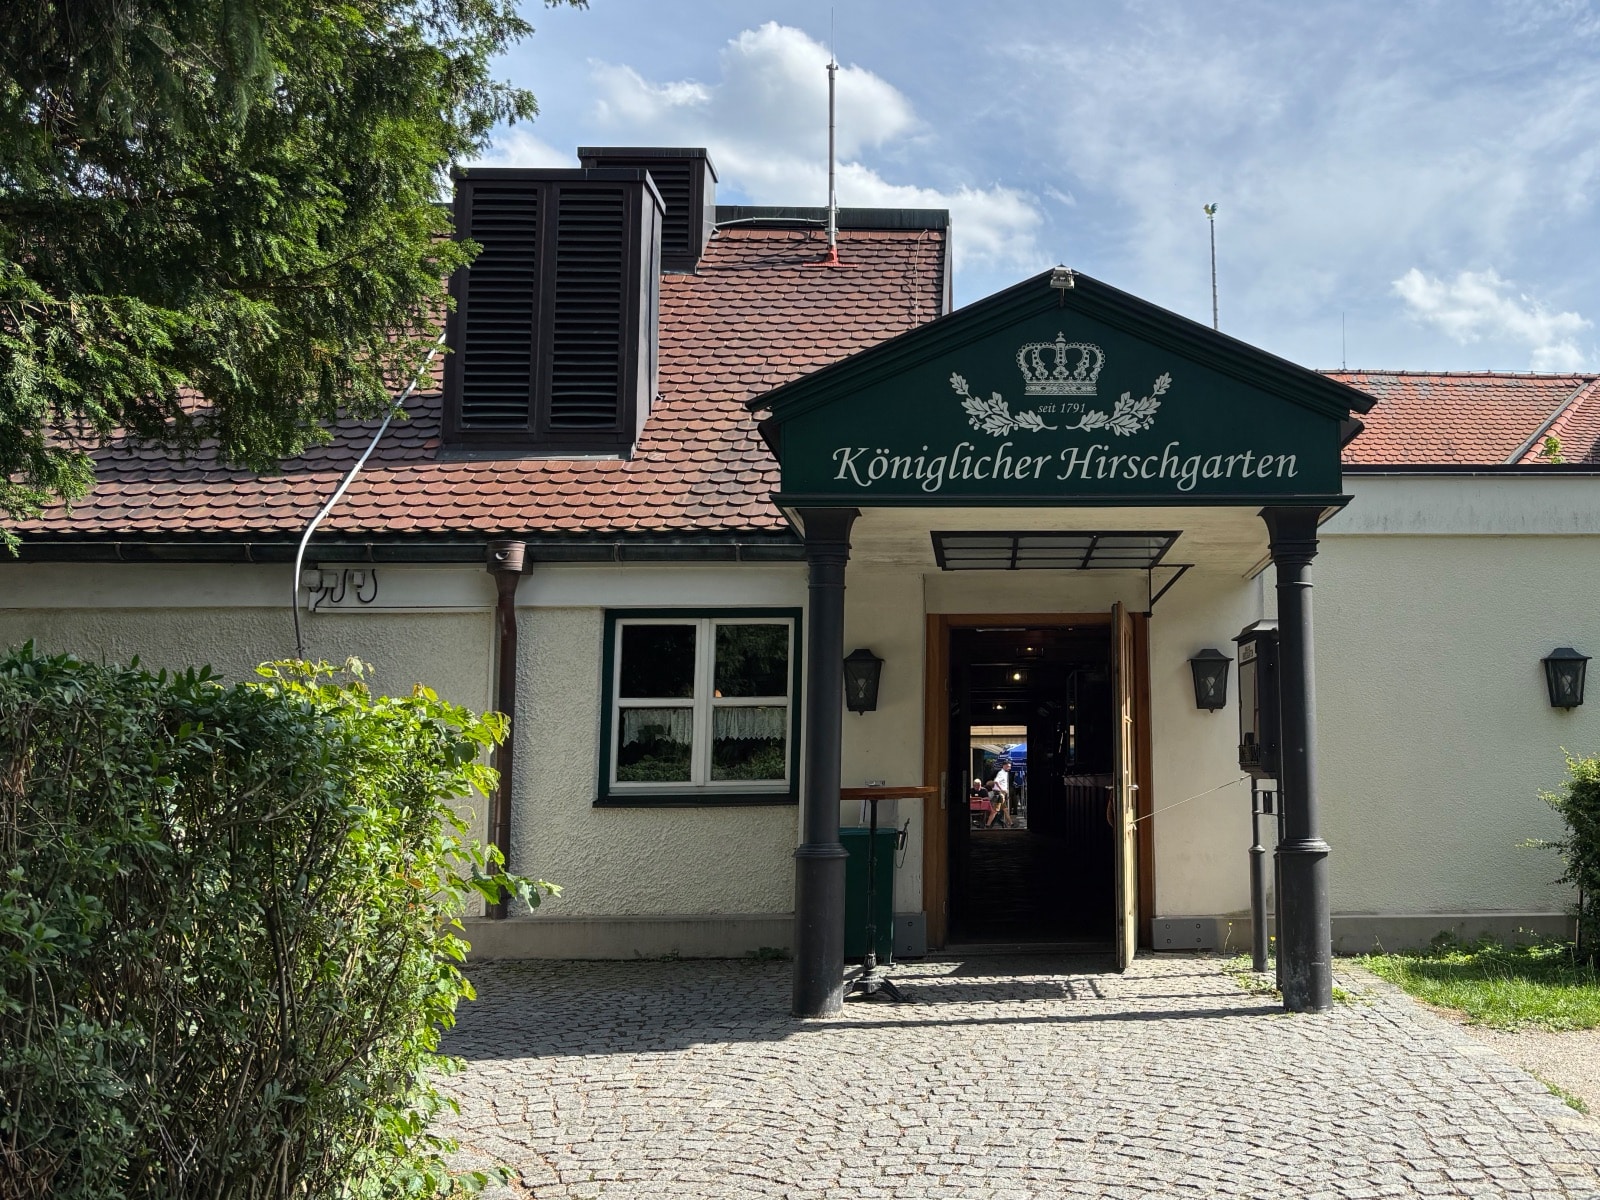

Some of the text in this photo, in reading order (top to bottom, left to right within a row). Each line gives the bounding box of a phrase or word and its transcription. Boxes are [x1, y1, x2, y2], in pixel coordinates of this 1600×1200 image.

[1037, 403, 1085, 413] seit 1791
[832, 441, 1299, 493] Königlicher Hirschgarten
